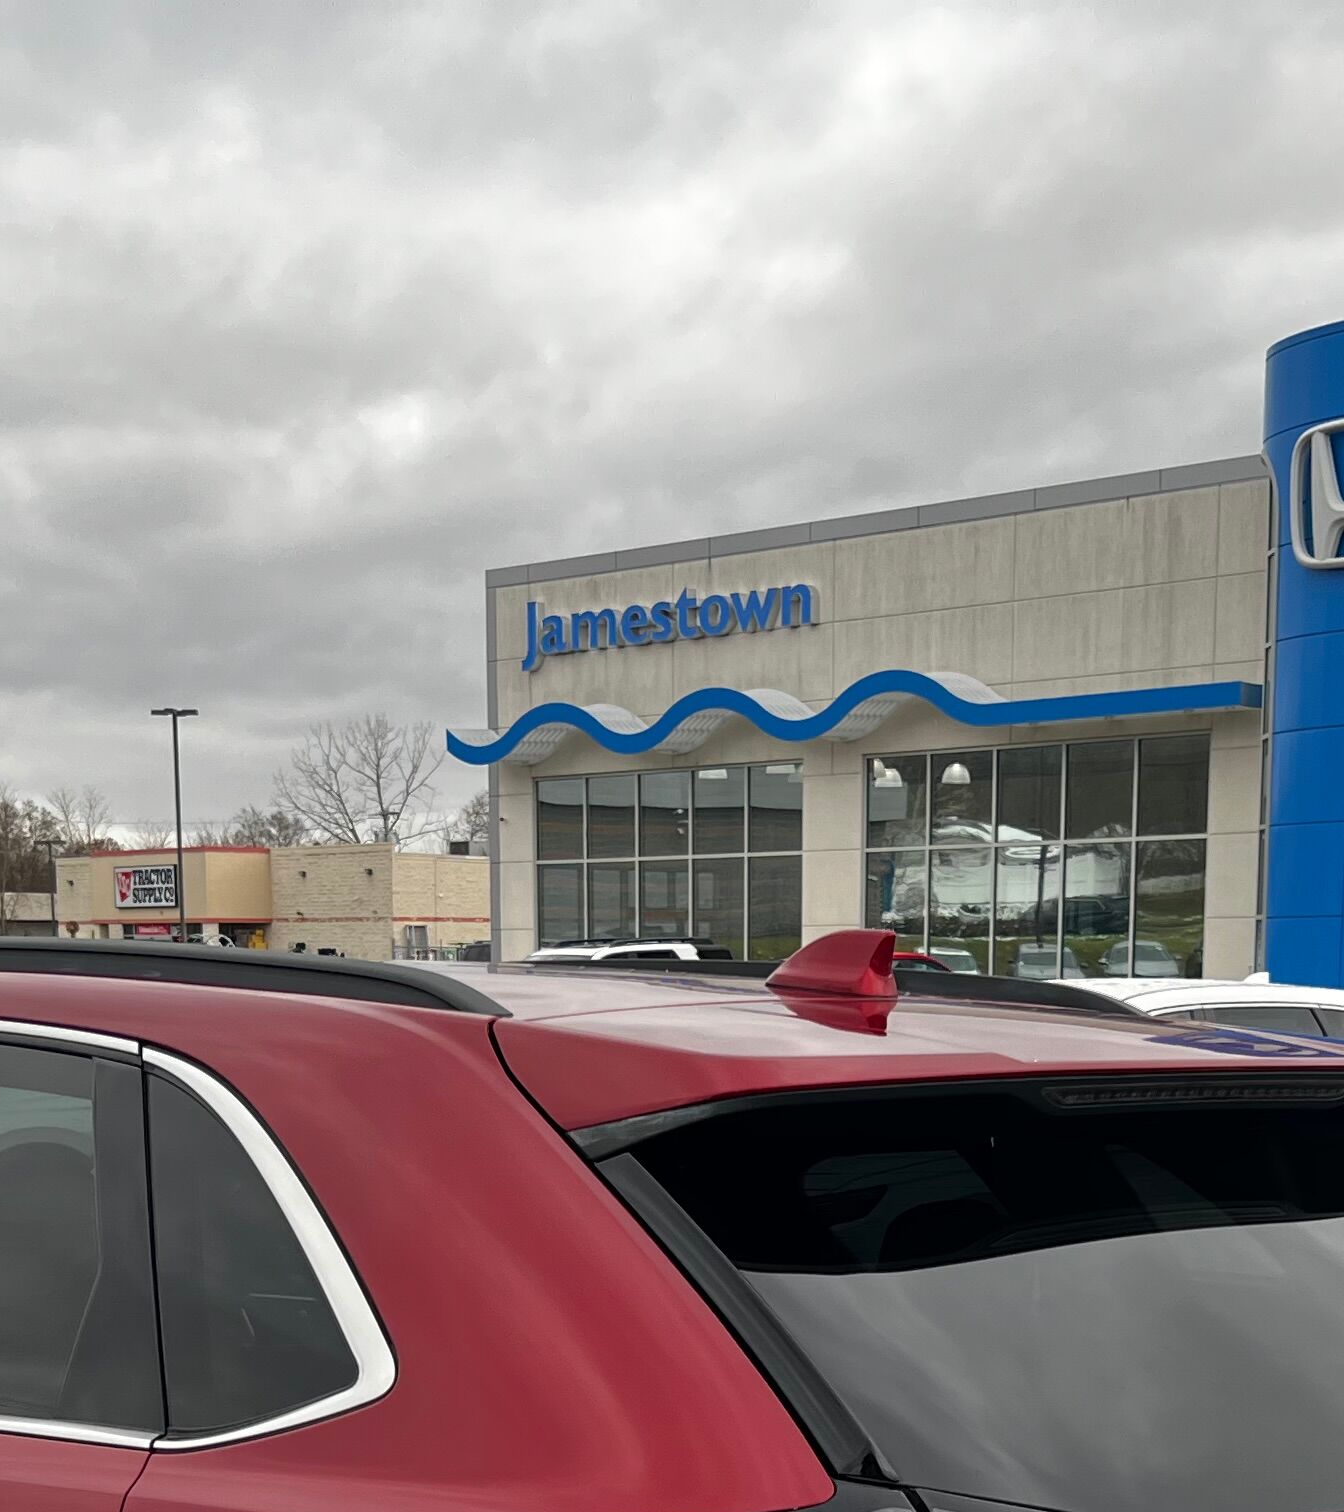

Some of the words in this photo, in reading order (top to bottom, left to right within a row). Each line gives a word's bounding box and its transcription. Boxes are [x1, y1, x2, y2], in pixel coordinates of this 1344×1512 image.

[521, 583, 816, 672] Jamestown
[132, 869, 173, 885] TRACTOR
[132, 887, 163, 903] SUPPLY
